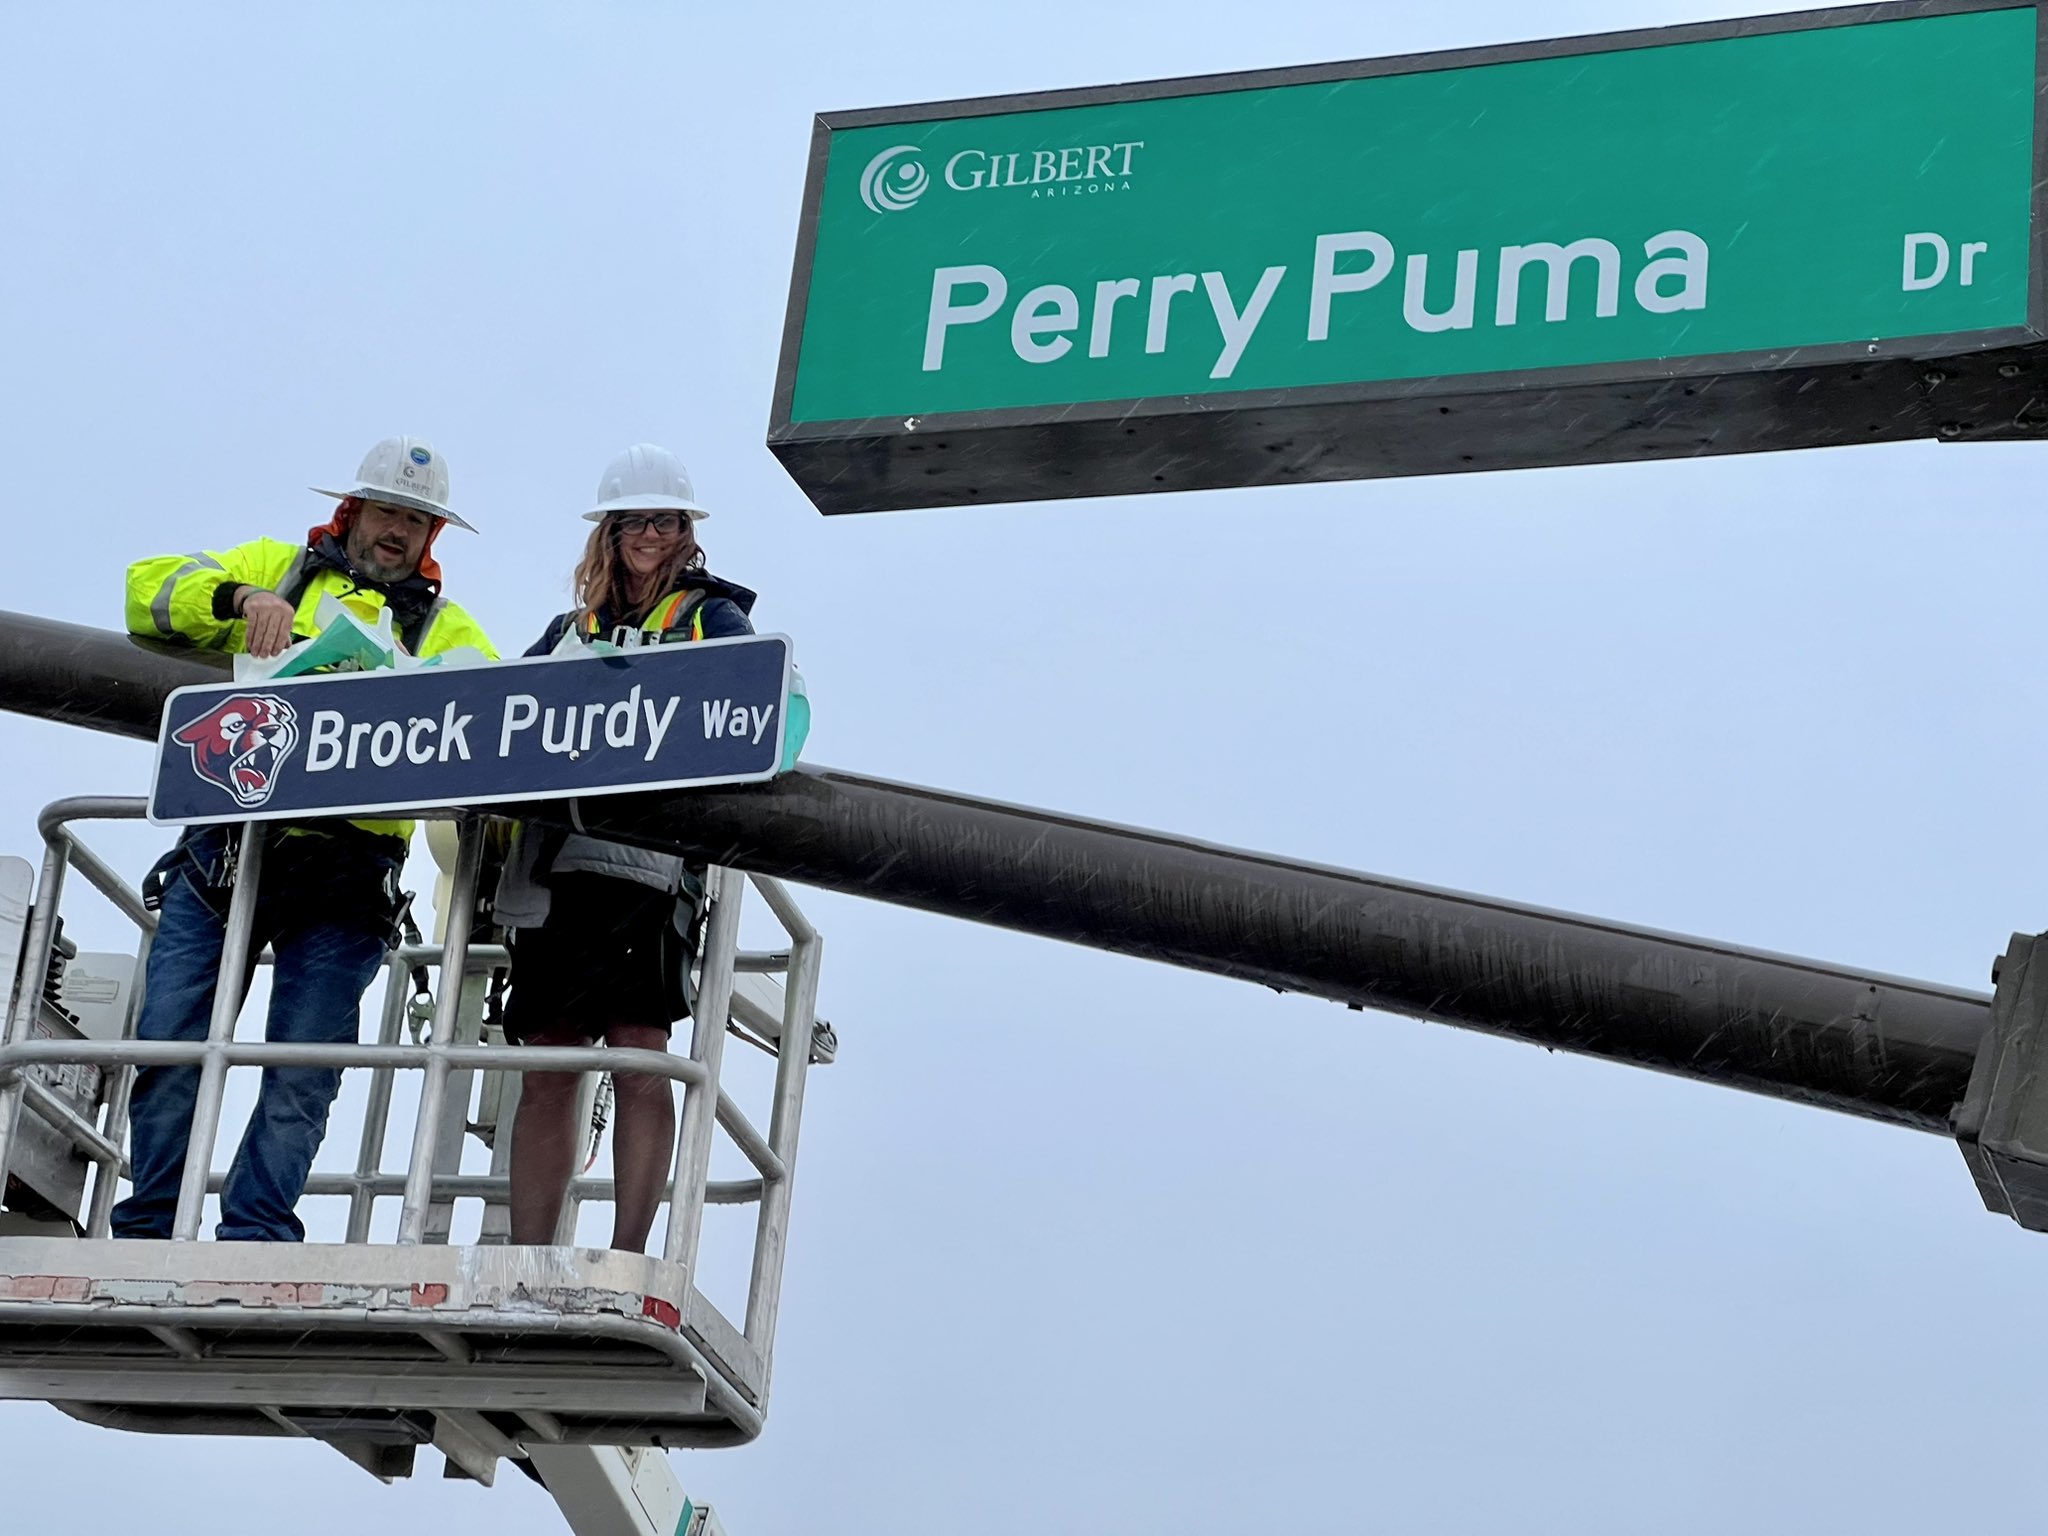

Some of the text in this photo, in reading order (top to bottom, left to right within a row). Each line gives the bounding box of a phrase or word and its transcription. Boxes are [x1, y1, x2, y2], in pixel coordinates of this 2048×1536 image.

[944, 141, 1144, 191] GILBERT
[1031, 181, 1131, 198] ARIZONA
[922, 230, 1988, 379] Perry Puma Dr
[305, 683, 774, 772] Brock Purdy Way
